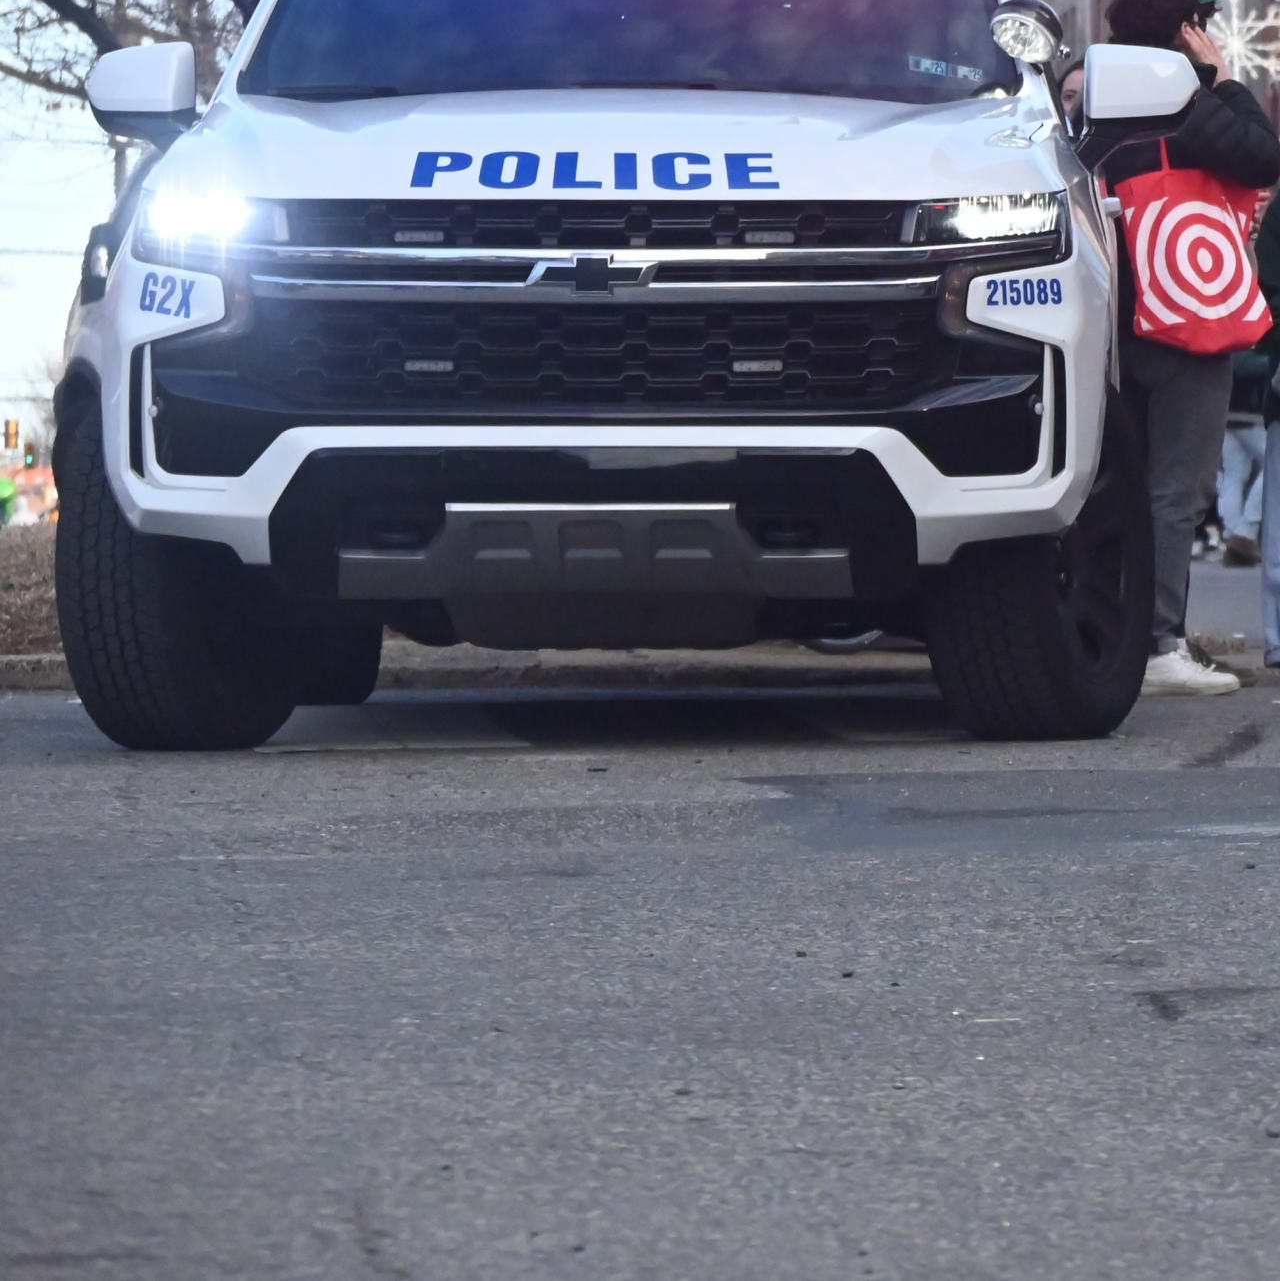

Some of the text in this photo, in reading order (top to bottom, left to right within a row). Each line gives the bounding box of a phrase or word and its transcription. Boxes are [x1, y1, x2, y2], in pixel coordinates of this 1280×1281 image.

[410, 151, 780, 190] POLICE
[139, 272, 196, 318] G2X
[986, 278, 1063, 306] 215089
